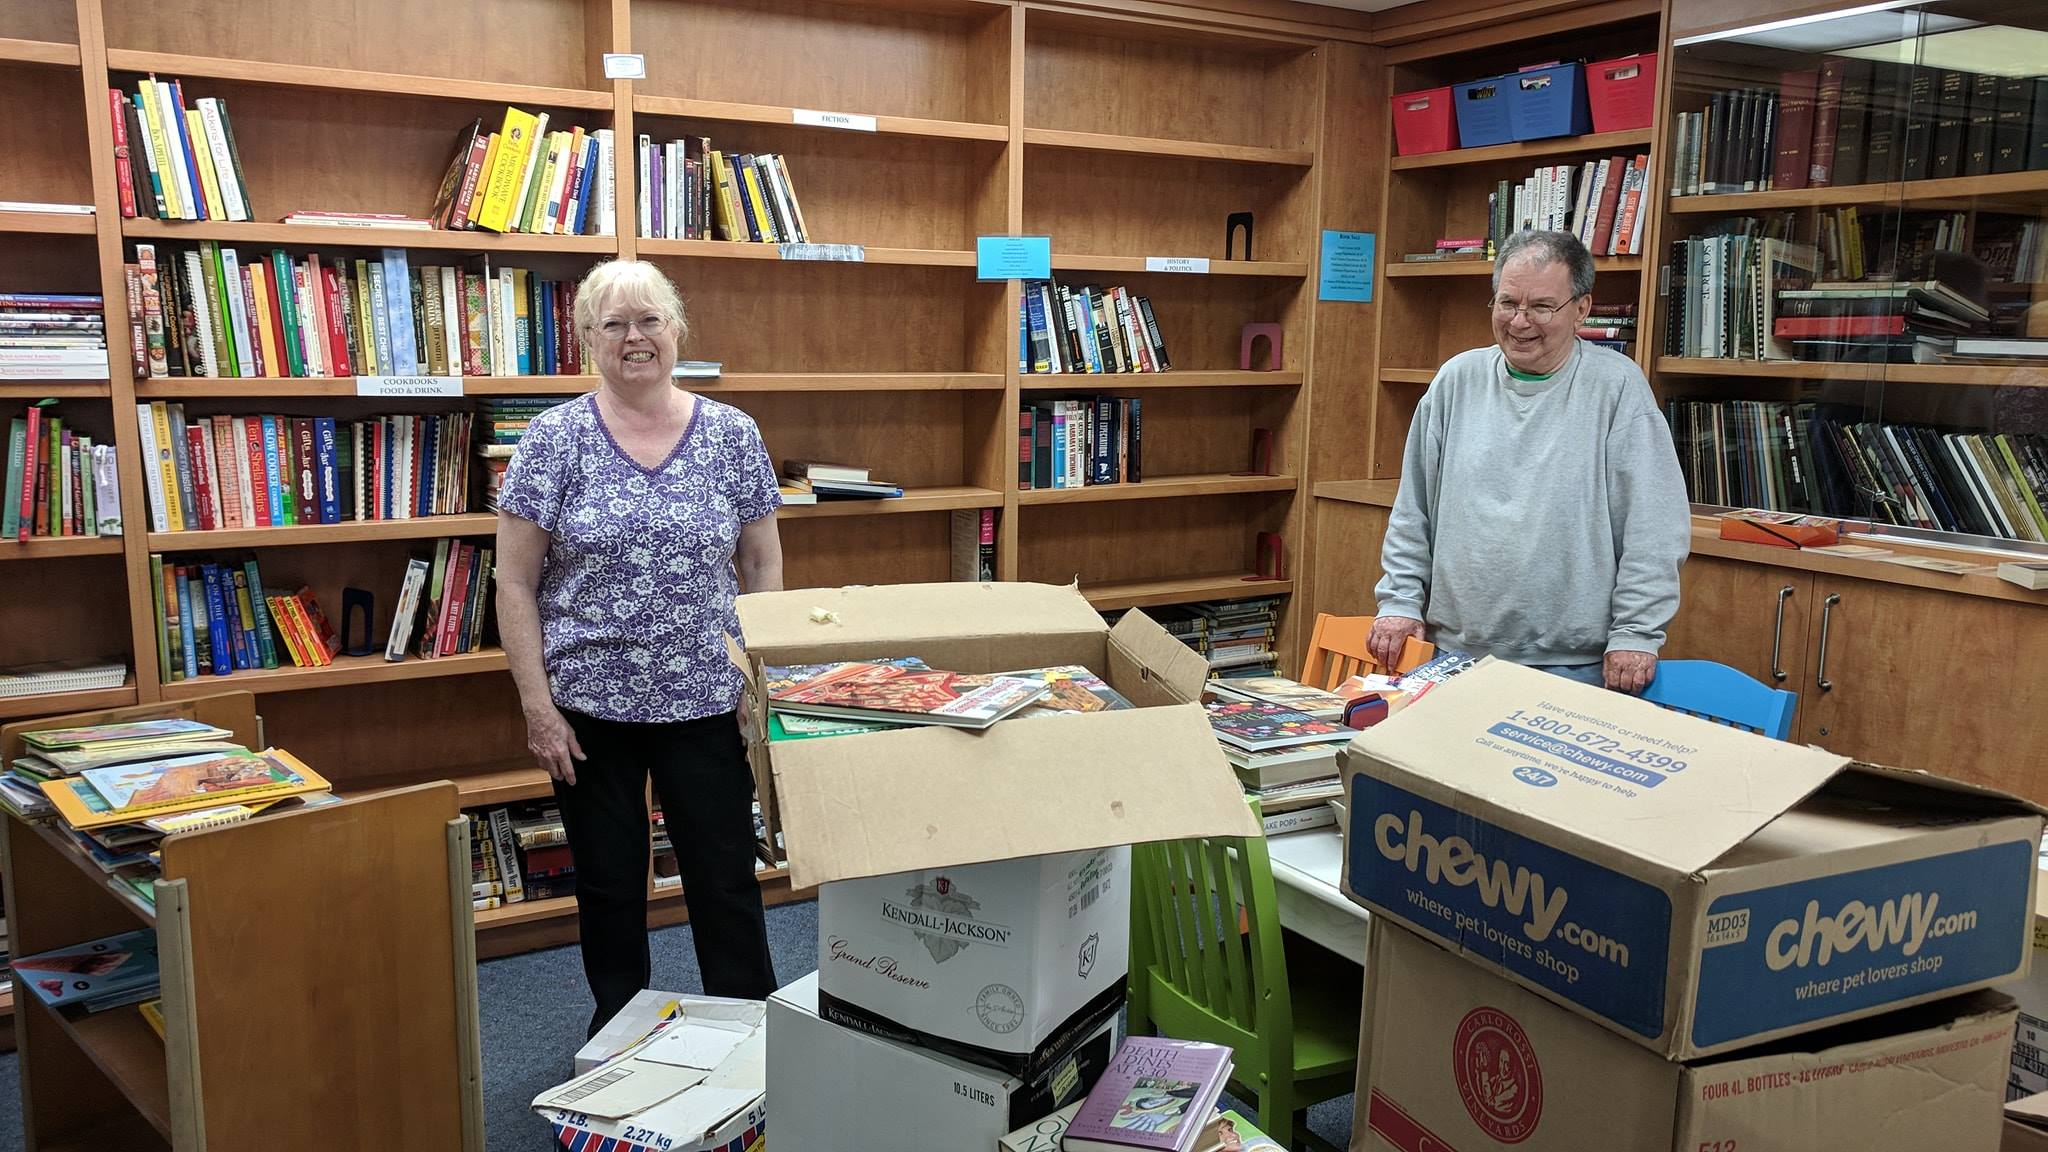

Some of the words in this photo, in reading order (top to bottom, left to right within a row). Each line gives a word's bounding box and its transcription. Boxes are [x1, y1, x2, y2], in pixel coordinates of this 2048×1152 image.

[205, 107, 218, 140] Atkins
[214, 143, 225, 157] for
[821, 115, 849, 124] FICTION
[492, 153, 508, 199] COOKBOOK
[499, 155, 518, 203] MICROWAVE
[1598, 164, 1606, 176] Bob
[373, 275, 382, 307] SECRETS
[164, 276, 172, 301] Graham
[169, 316, 179, 348] Cookbook
[1064, 301, 1076, 331] BUNKER
[134, 326, 144, 351] RACHAEL
[377, 317, 385, 336] BEST
[517, 320, 526, 356] COOKBOOK
[136, 352, 145, 362] RAY
[379, 337, 388, 361] CHEFS
[434, 340, 442, 362] SMITH
[380, 387, 404, 395] FOOD
[384, 378, 438, 386] COOKBOOKS
[247, 422, 259, 441] Ten
[265, 427, 275, 452] SLOW
[300, 430, 312, 451] Gifts
[322, 430, 333, 450] Gifts
[1099, 422, 1108, 458] EXPECTATIONS
[14, 431, 26, 467] domino
[320, 453, 329, 466] Jar
[251, 452, 262, 480] Sheila
[267, 453, 278, 487] COOKER
[254, 481, 265, 512] Lukins
[213, 584, 220, 596] ON
[1538, 700, 1565, 717] Have
[1565, 708, 1618, 733] questions
[1618, 726, 1631, 737] or
[1631, 730, 1663, 749] need
[1662, 737, 1698, 756] help?
[1500, 725, 1649, 783] service@chewy.com
[1505, 709, 1687, 775] 1-800-672-4399
[1475, 737, 1497, 749] Call
[1498, 743, 1509, 751] us
[1508, 744, 1543, 765] anytime,
[1544, 758, 1567, 775] we're
[1567, 765, 1601, 788] happy
[1601, 778, 1612, 788] to
[1612, 781, 1638, 799] help
[1516, 767, 1554, 786] 24/7
[1281, 817, 1298, 830] POPS
[1373, 809, 1630, 968] chewy.com
[881, 902, 1008, 942] KENDALL-JACKSON
[1708, 913, 1747, 934] MD03
[1765, 891, 1977, 972] chewy.com
[1406, 888, 1452, 921] where
[1455, 909, 1481, 935] pet
[1482, 922, 1533, 959] lovers
[1535, 948, 1580, 985] shop
[828, 934, 872, 970] Grand
[875, 956, 930, 990] Reserve
[1795, 974, 1840, 1001] where
[1842, 969, 1866, 989] pet
[1868, 962, 1908, 985] lovers
[1911, 954, 1943, 974] shop
[1122, 1044, 1179, 1060] DEATH
[1466, 1014, 1505, 1034] CARLO
[1505, 1023, 1535, 1070] ROSSI
[1110, 1062, 1131, 1075] AT
[1133, 1065, 1169, 1078] 8:30
[1123, 1054, 1174, 1070] DINES
[953, 1081, 968, 1097] 10.5
[969, 1087, 995, 1107] LITERS
[1702, 1081, 1730, 1101] FOUR
[1731, 1079, 1744, 1096] 4L.
[1747, 1071, 1791, 1093] BOTTLES
[556, 1109, 567, 1121] 5
[568, 1112, 588, 1128] LB.
[748, 1111, 756, 1125] 5
[1462, 1082, 1527, 1136] VINEYARDS
[623, 1125, 656, 1143] 2.27
[656, 1133, 673, 1151] kg
